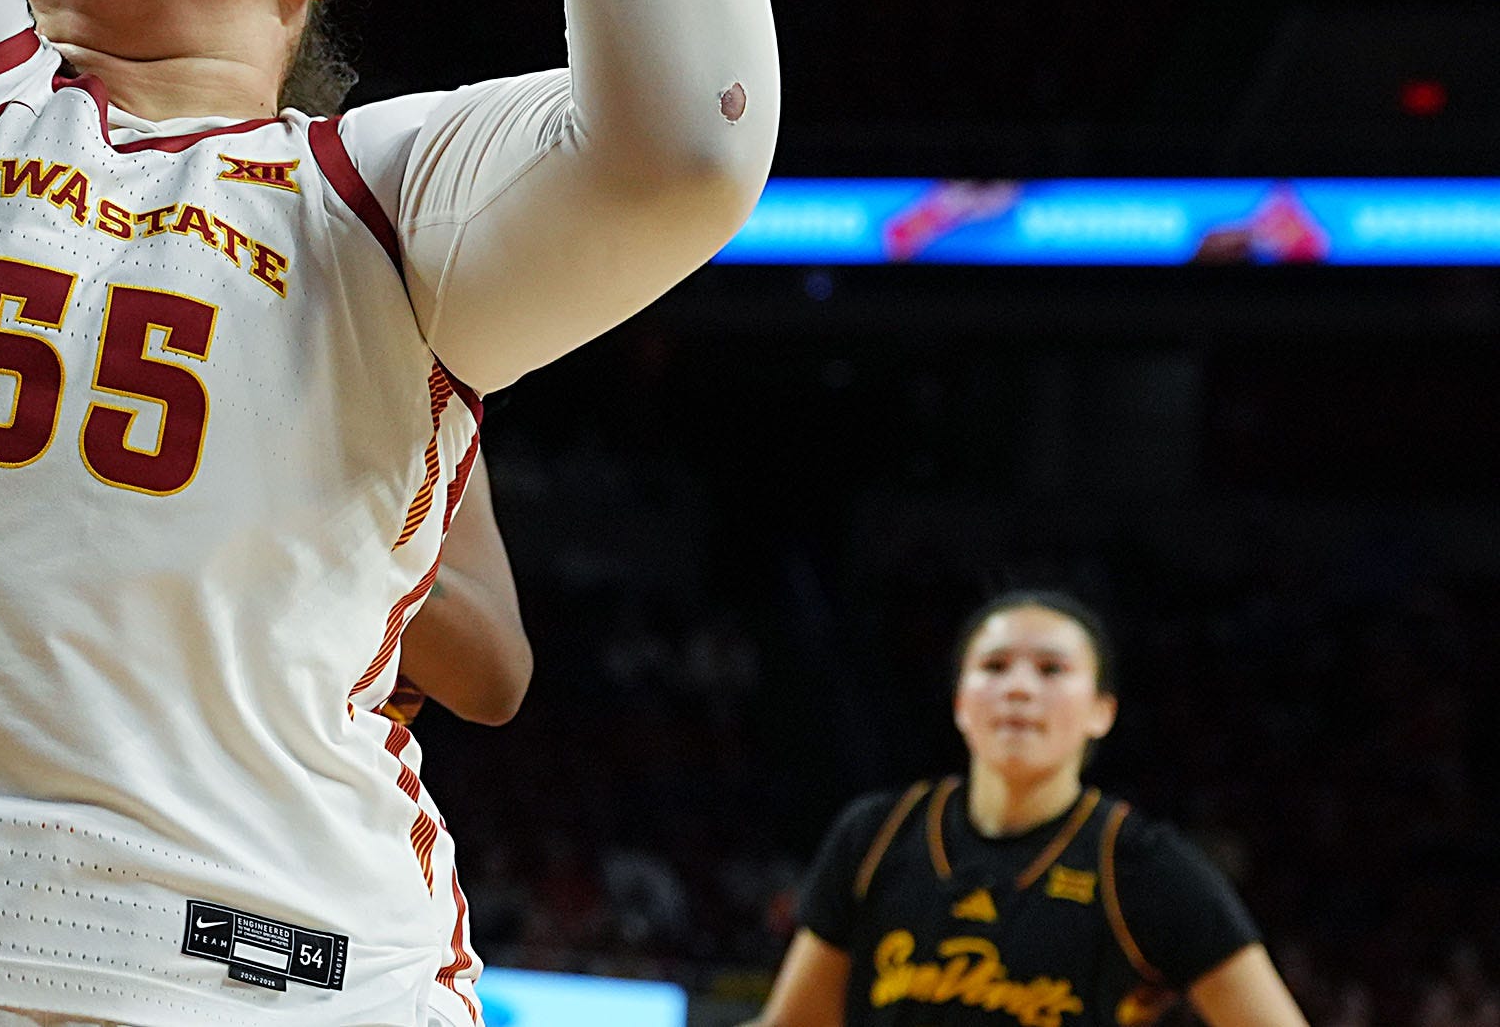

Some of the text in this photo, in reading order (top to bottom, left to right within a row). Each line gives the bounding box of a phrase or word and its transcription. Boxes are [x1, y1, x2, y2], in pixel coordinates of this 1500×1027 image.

[217, 153, 302, 195] XII
[94, 197, 290, 300] STATE
[194, 933, 228, 948] TEAM
[237, 917, 290, 938] ENGINEERED
[299, 943, 324, 970] 54
